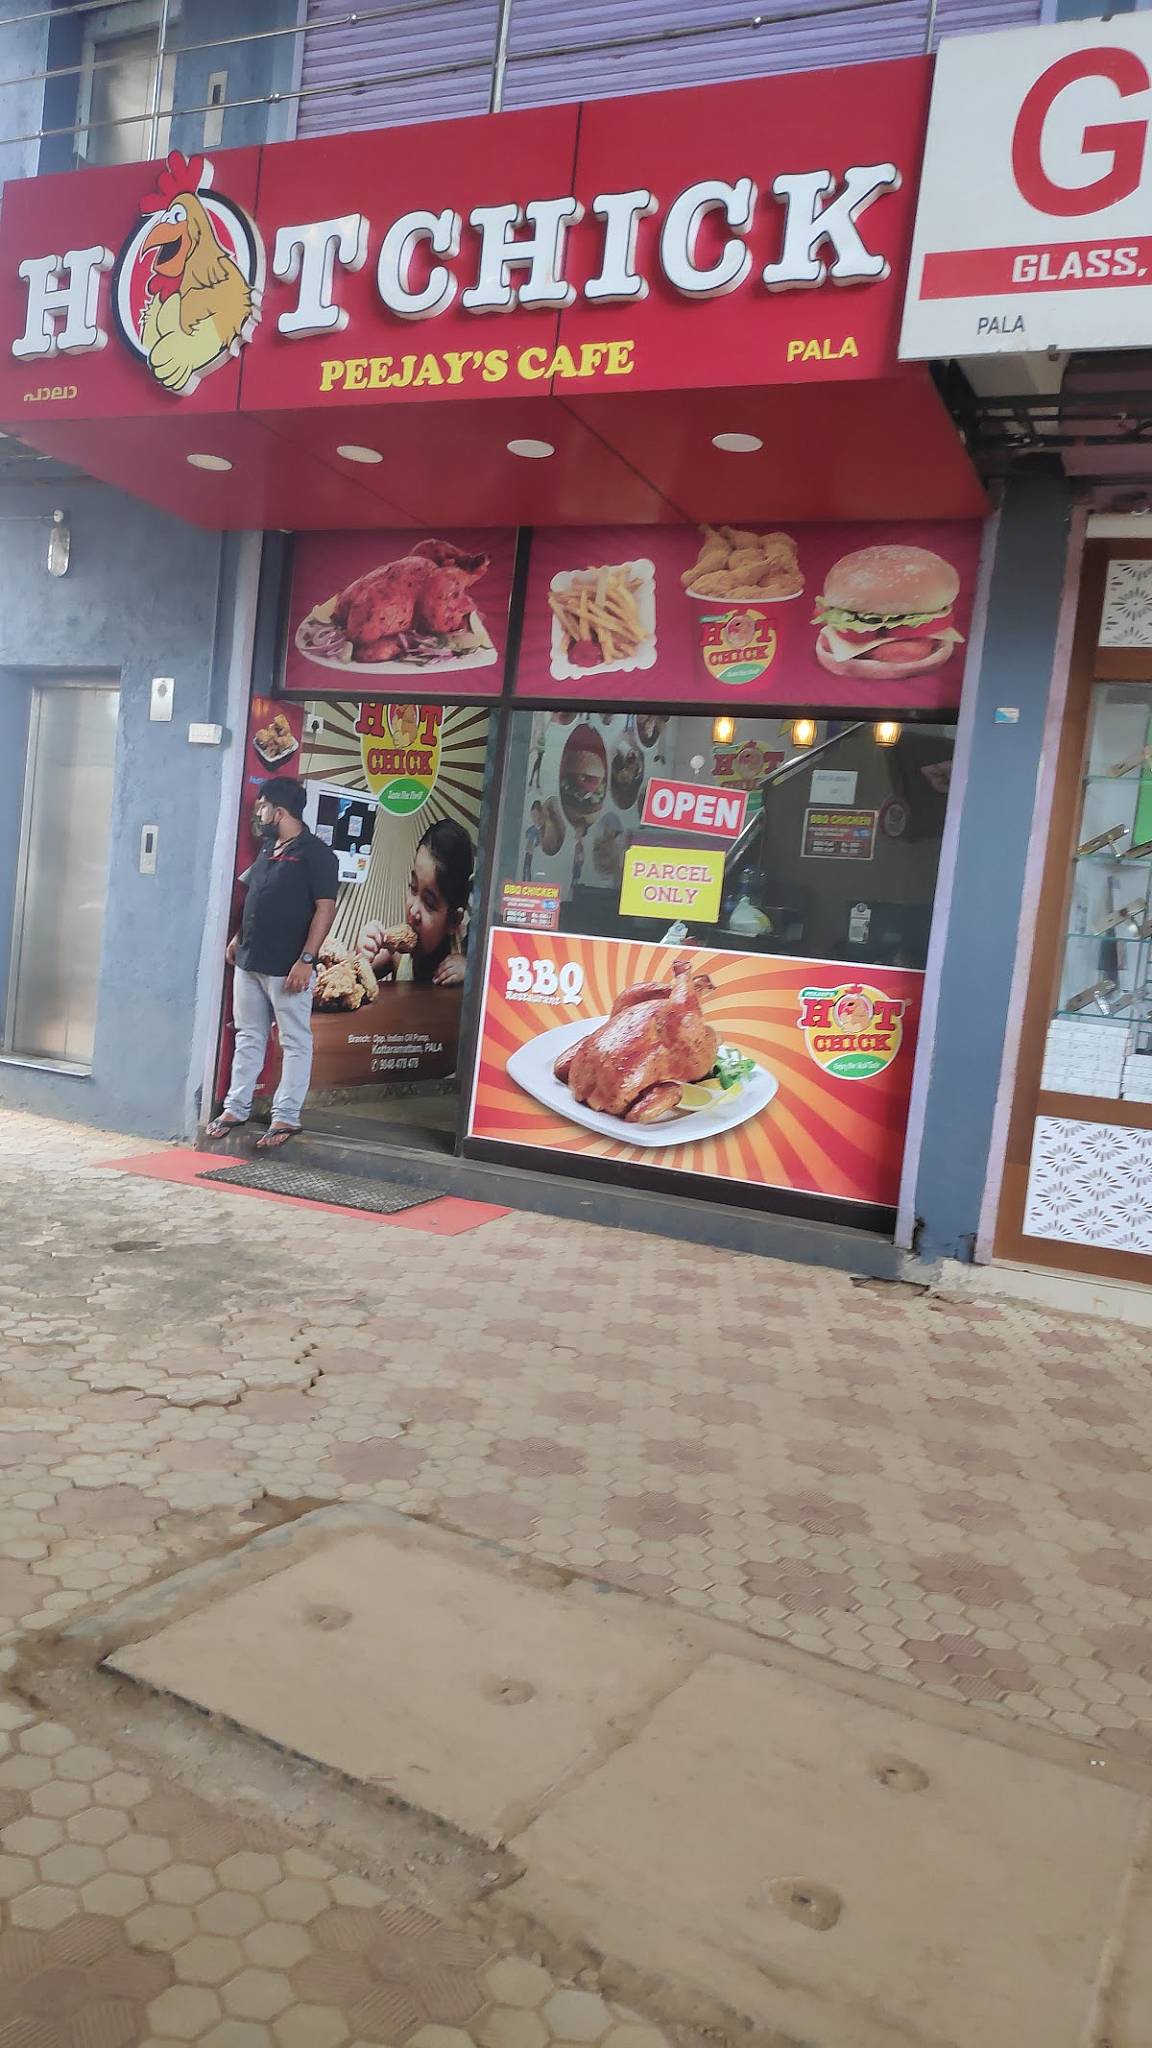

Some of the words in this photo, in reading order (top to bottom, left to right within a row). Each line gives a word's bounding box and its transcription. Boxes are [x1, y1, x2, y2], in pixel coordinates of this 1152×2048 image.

[1011, 247, 1148, 283] GLASS,
[976, 315, 1026, 335] PALA
[787, 337, 859, 362] PALA
[319, 349, 509, 392] PEEJAY'S
[517, 340, 635, 380] CAFE
[23, 385, 78, 402] പാലാ
[367, 748, 433, 776] CHICK
[651, 788, 741, 830] OPEN
[633, 861, 713, 883] PARCEL
[643, 885, 699, 904] ONLY
[506, 956, 583, 1006] BBQ
[801, 998, 902, 1031] HOT
[424, 1042, 443, 1054] PALA
[813, 1033, 892, 1053] CHICK
